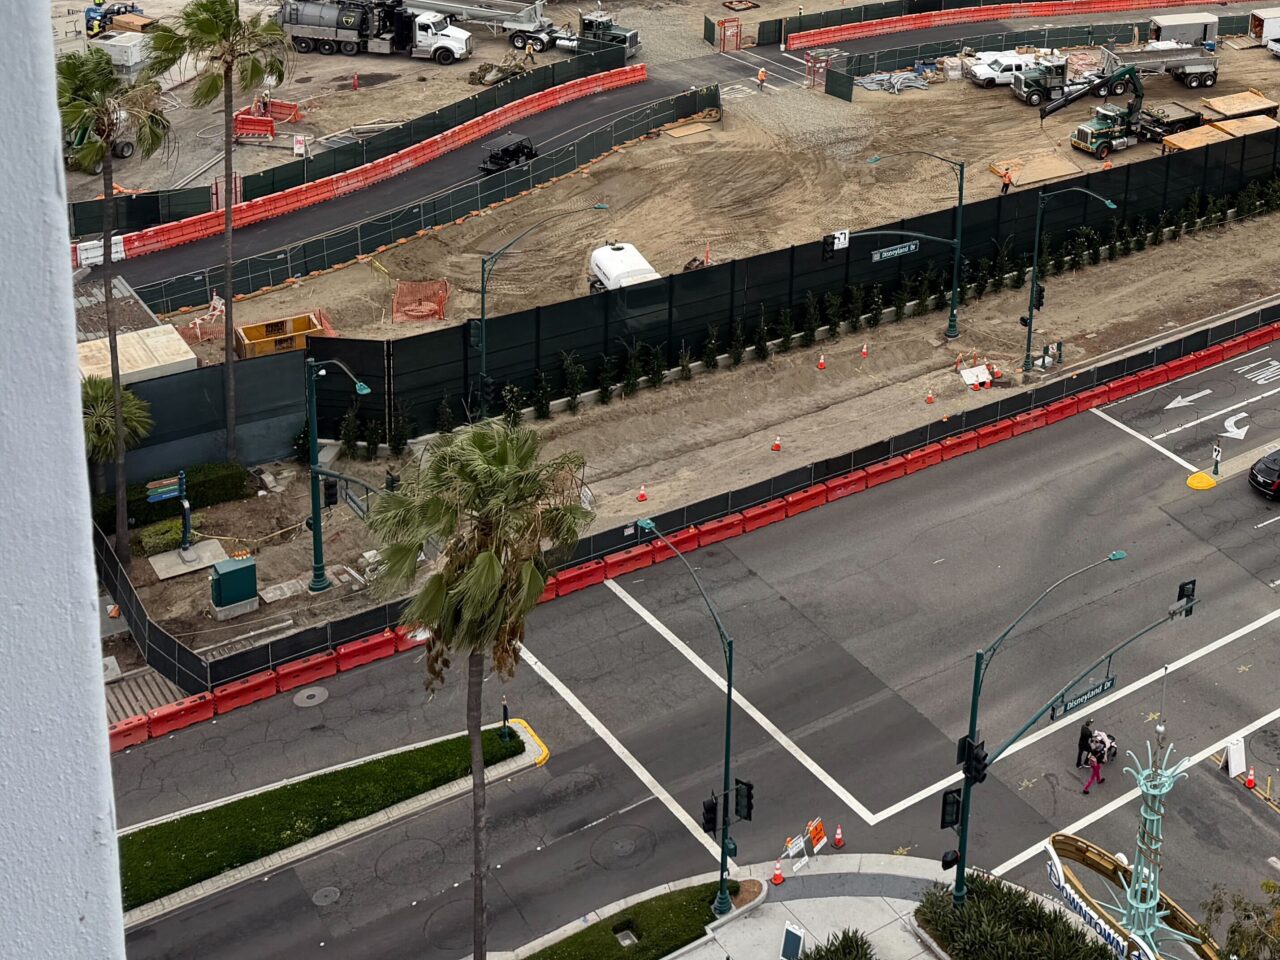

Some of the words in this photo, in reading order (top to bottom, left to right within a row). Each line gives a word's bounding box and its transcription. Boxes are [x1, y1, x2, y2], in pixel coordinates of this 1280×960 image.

[881, 246, 909, 258] Disneyland
[909, 244, 916, 252] Dr
[1066, 684, 1103, 711] Disneyland
[1103, 680, 1113, 690] Dr
